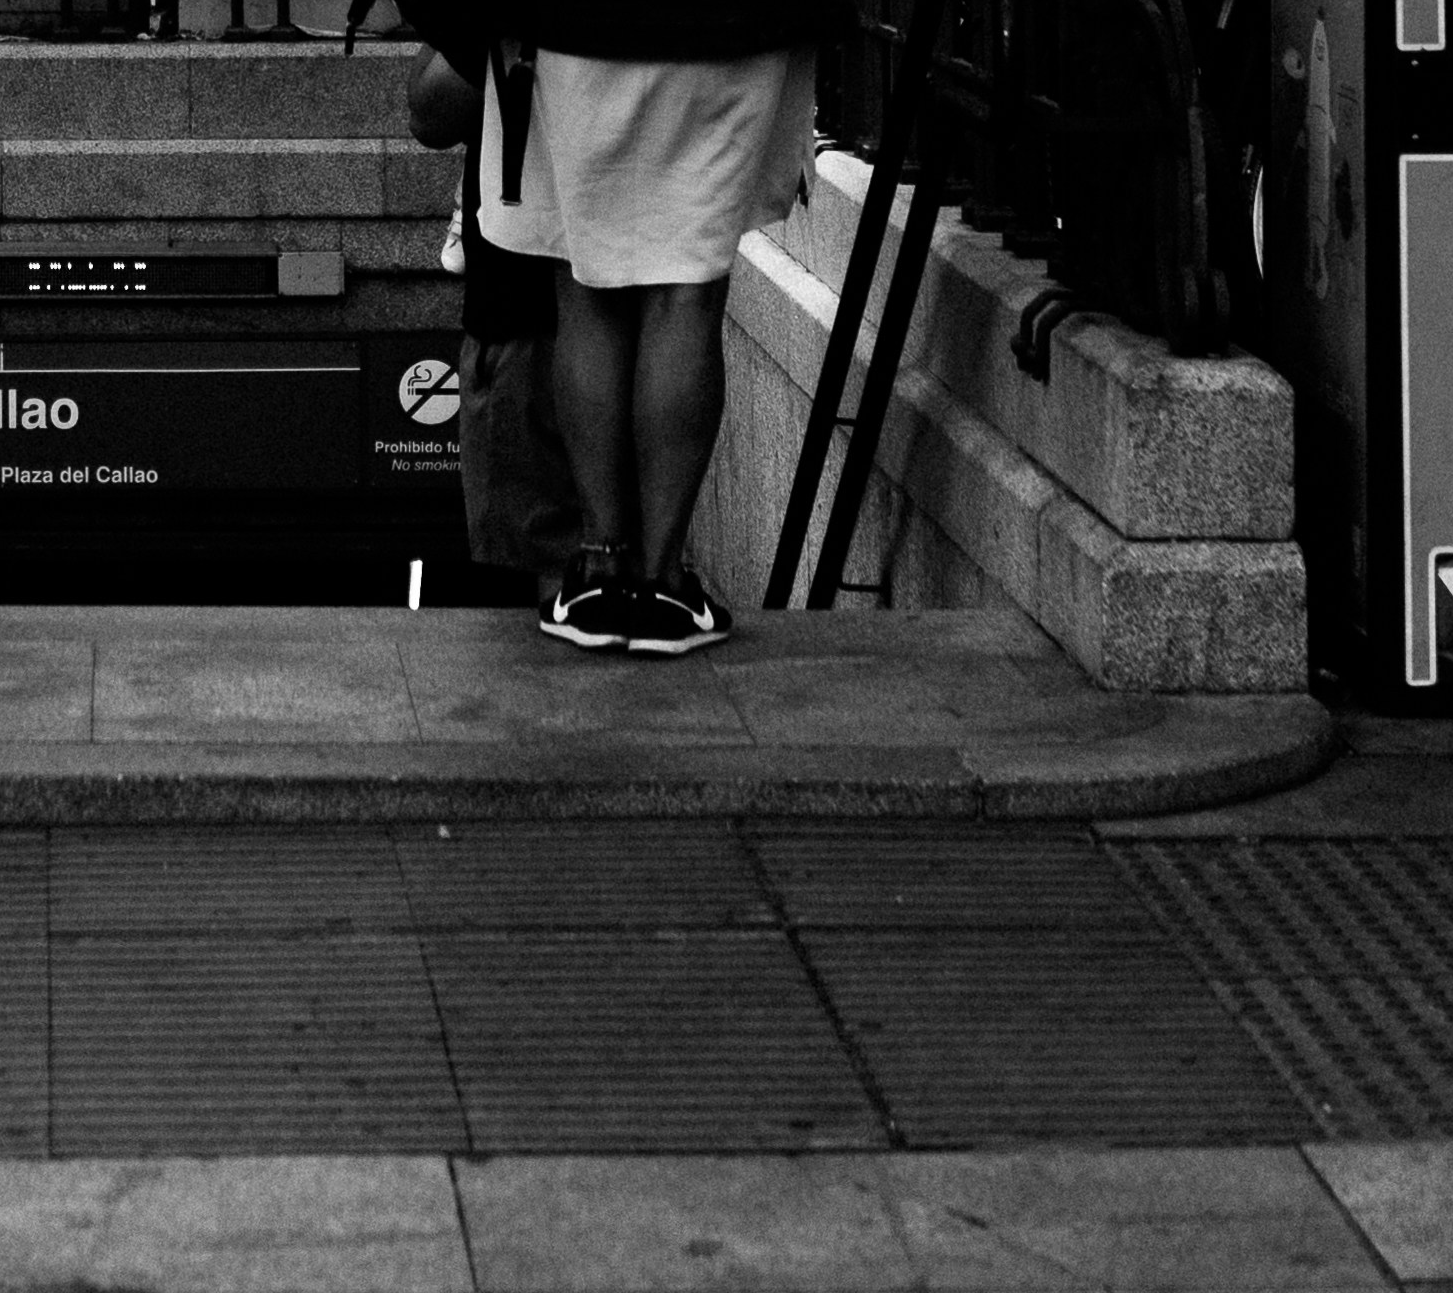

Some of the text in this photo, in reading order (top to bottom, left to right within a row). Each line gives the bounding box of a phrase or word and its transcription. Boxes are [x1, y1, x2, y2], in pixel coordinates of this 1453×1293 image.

[374, 441, 443, 454] Prohibido
[391, 459, 462, 472] No smokin
[0, 465, 54, 485] Plaza
[59, 465, 90, 484] del
[95, 465, 159, 485] Callao
